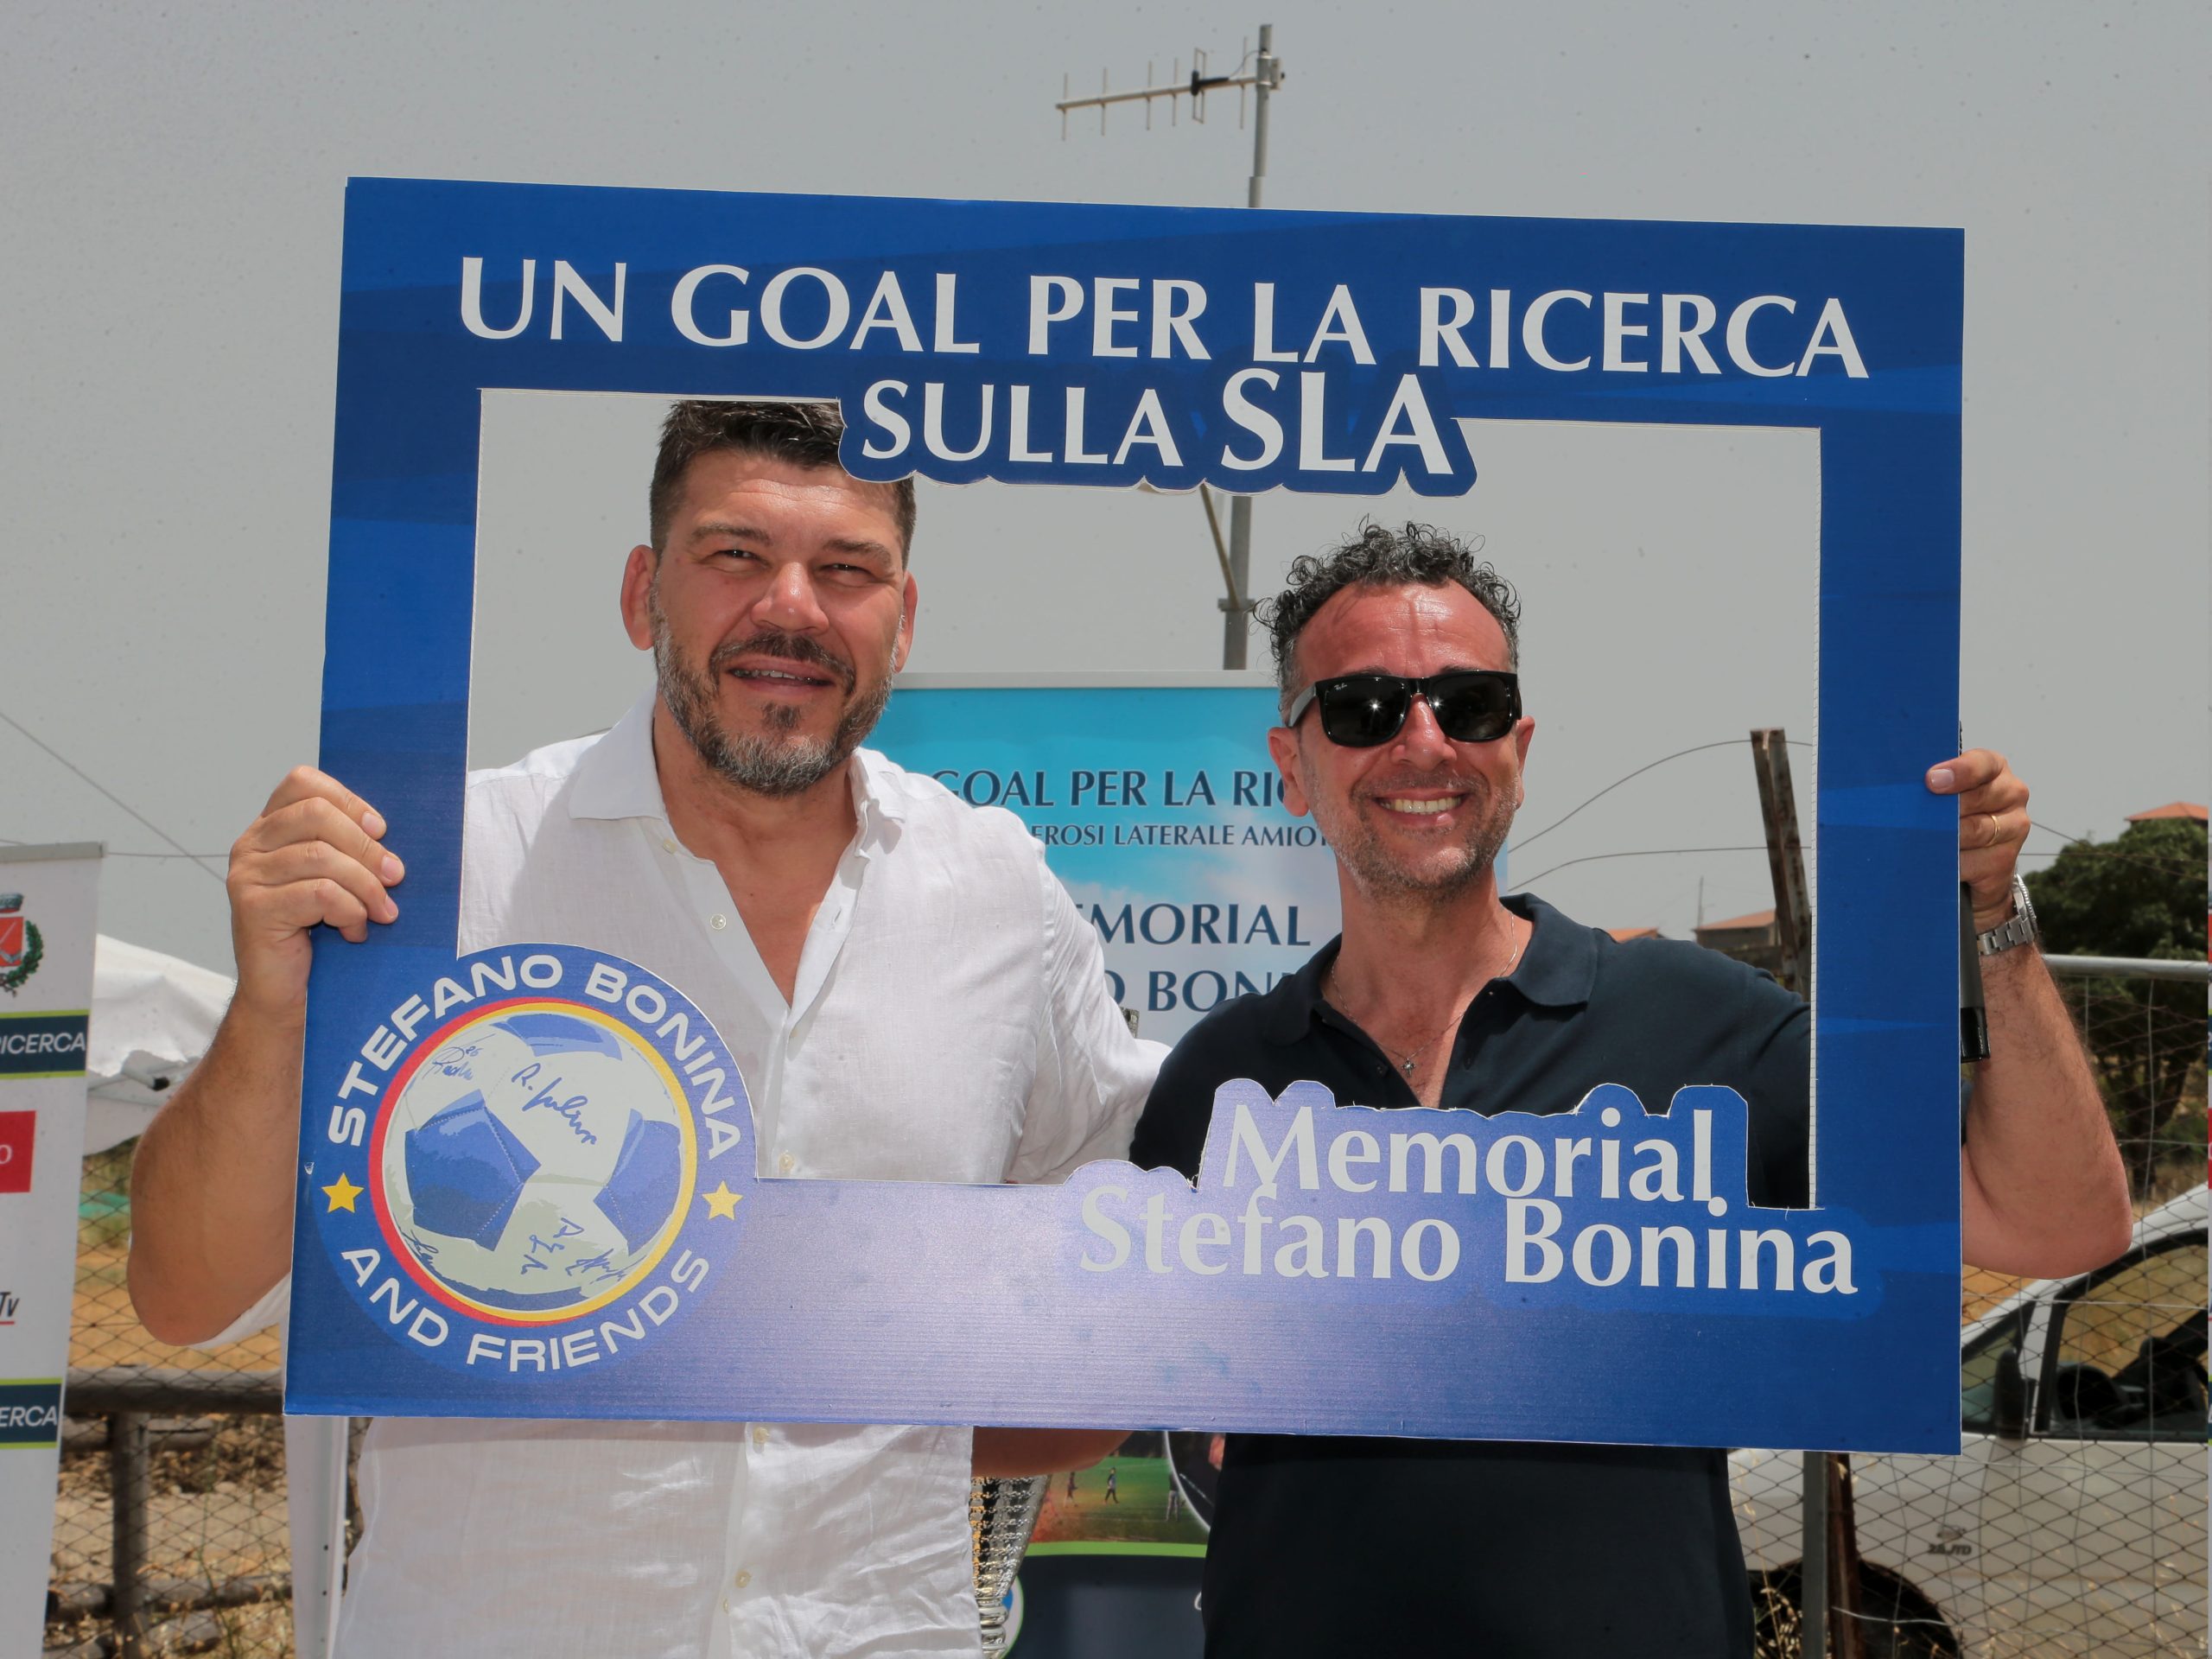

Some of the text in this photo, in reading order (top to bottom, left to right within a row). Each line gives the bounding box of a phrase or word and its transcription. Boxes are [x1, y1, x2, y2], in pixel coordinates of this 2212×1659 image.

[460, 256, 1870, 379] UN GOAL PER LA RICERCA
[861, 367, 1455, 475] SULLA SLA
[1071, 771, 1147, 806] PER
[1164, 771, 1216, 806] LA
[1233, 771, 1285, 807] RI
[1115, 824, 1235, 846] LATERALE
[1075, 903, 1311, 946] MORIAL
[0, 1033, 86, 1054] ICERCA
[327, 954, 741, 1160] STEFANO BONINA
[1222, 1103, 1713, 1203] Memorial
[1078, 1179, 1859, 1295] Stefano Bonina
[340, 1248, 709, 1372] AND FRIENDS
